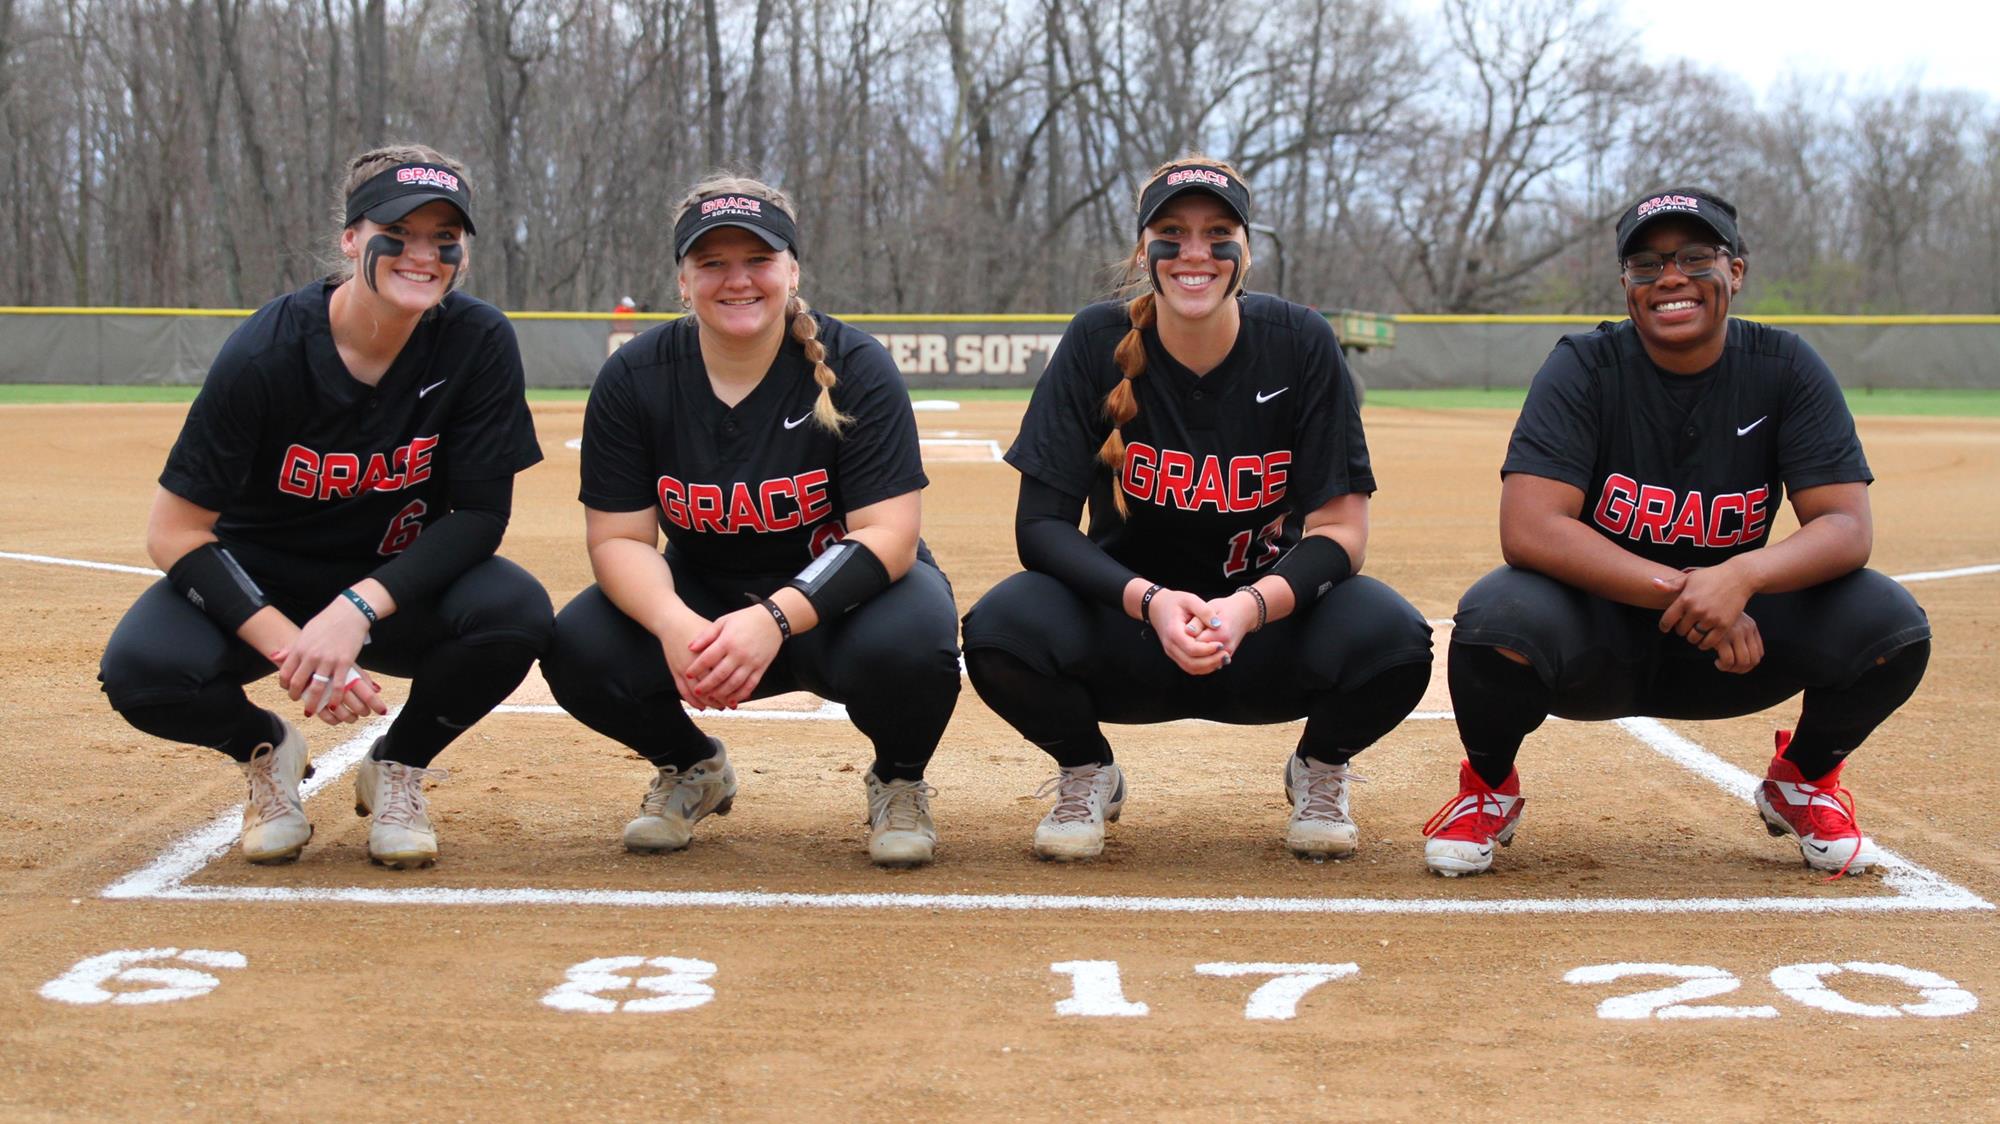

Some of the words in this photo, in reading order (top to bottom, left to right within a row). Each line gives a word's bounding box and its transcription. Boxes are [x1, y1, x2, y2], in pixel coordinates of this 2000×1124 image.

[397, 167, 459, 191] GRACE
[701, 196, 762, 214] GRACE
[1167, 169, 1228, 187] GRACE
[1637, 195, 1698, 215] GRACE
[711, 209, 751, 217] SOFTBALL
[1647, 205, 1687, 215] SOFTBALL
[278, 434, 440, 500] GRACE
[1122, 442, 1292, 512] GRACE
[376, 498, 427, 556] 6
[657, 468, 832, 534] GRACE
[1593, 473, 1769, 548] GRACE
[38, 947, 248, 1005] 6
[540, 955, 718, 1014] 8
[1050, 959, 1360, 1020] 17
[1562, 961, 1979, 1019] 20
